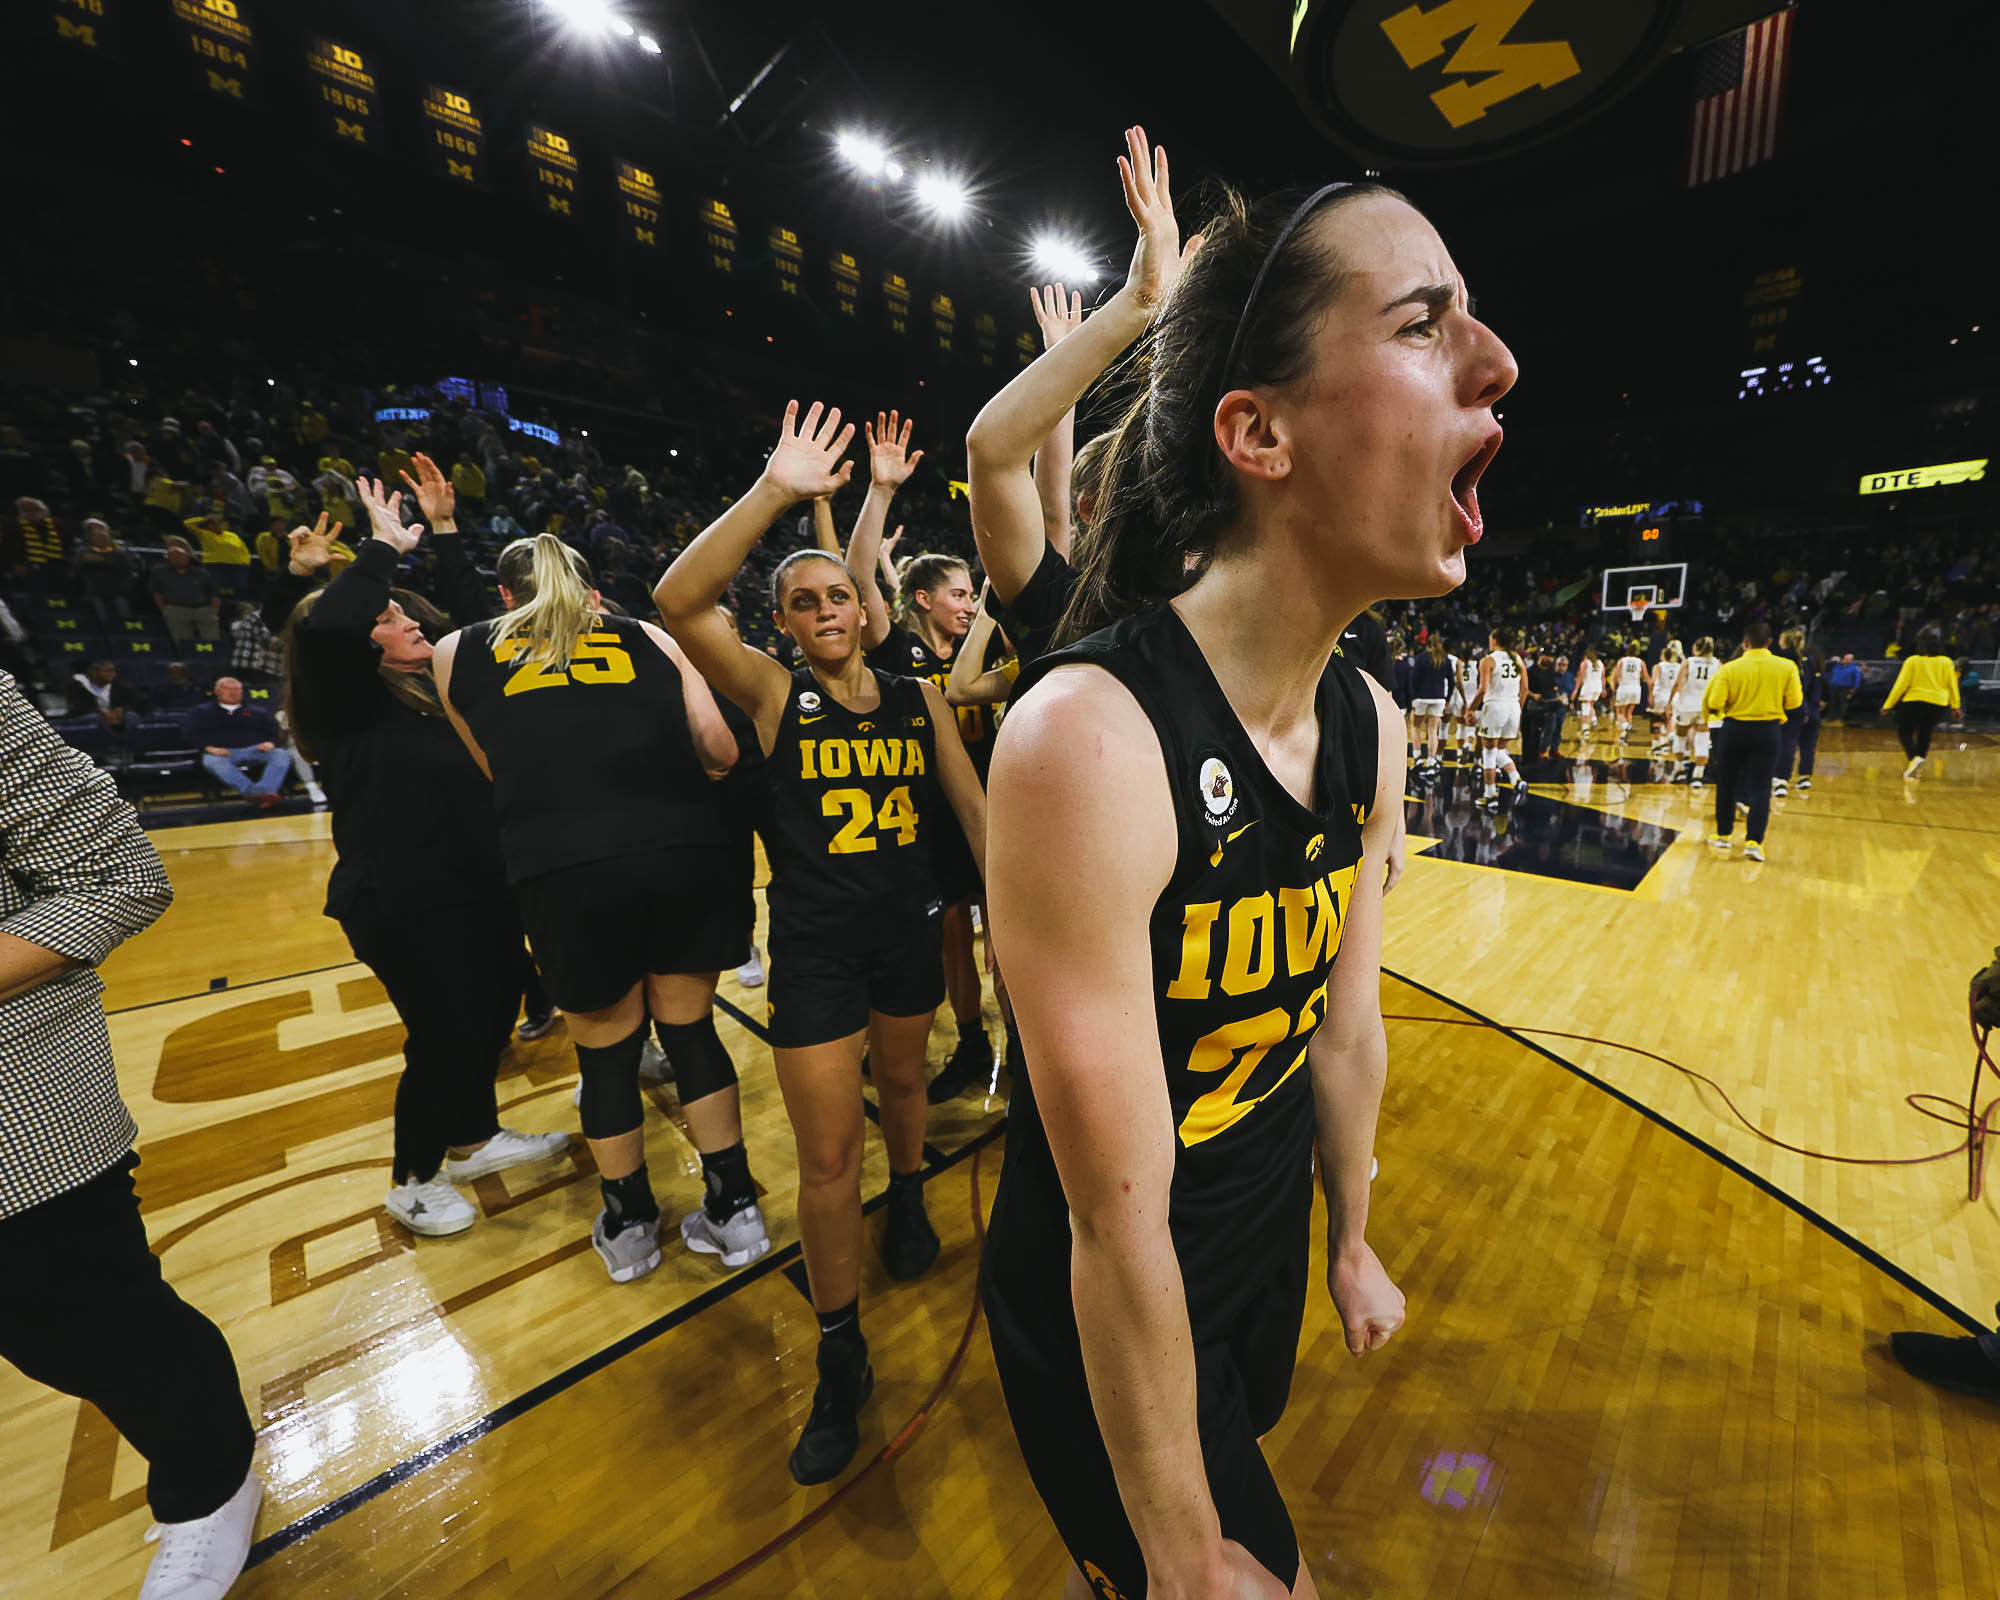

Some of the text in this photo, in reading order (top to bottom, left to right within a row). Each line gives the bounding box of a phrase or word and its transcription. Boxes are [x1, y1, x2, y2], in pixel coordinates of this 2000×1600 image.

[190, 32, 248, 71] 1964
[320, 84, 369, 116] 1965
[435, 128, 478, 157] 1966
[1872, 472, 1922, 491] DTE
[494, 633, 636, 696] 25
[799, 738, 926, 779] IOWA
[821, 786, 919, 854] 24
[1205, 797, 1239, 827] United As One
[1166, 856, 1364, 1000] IOW
